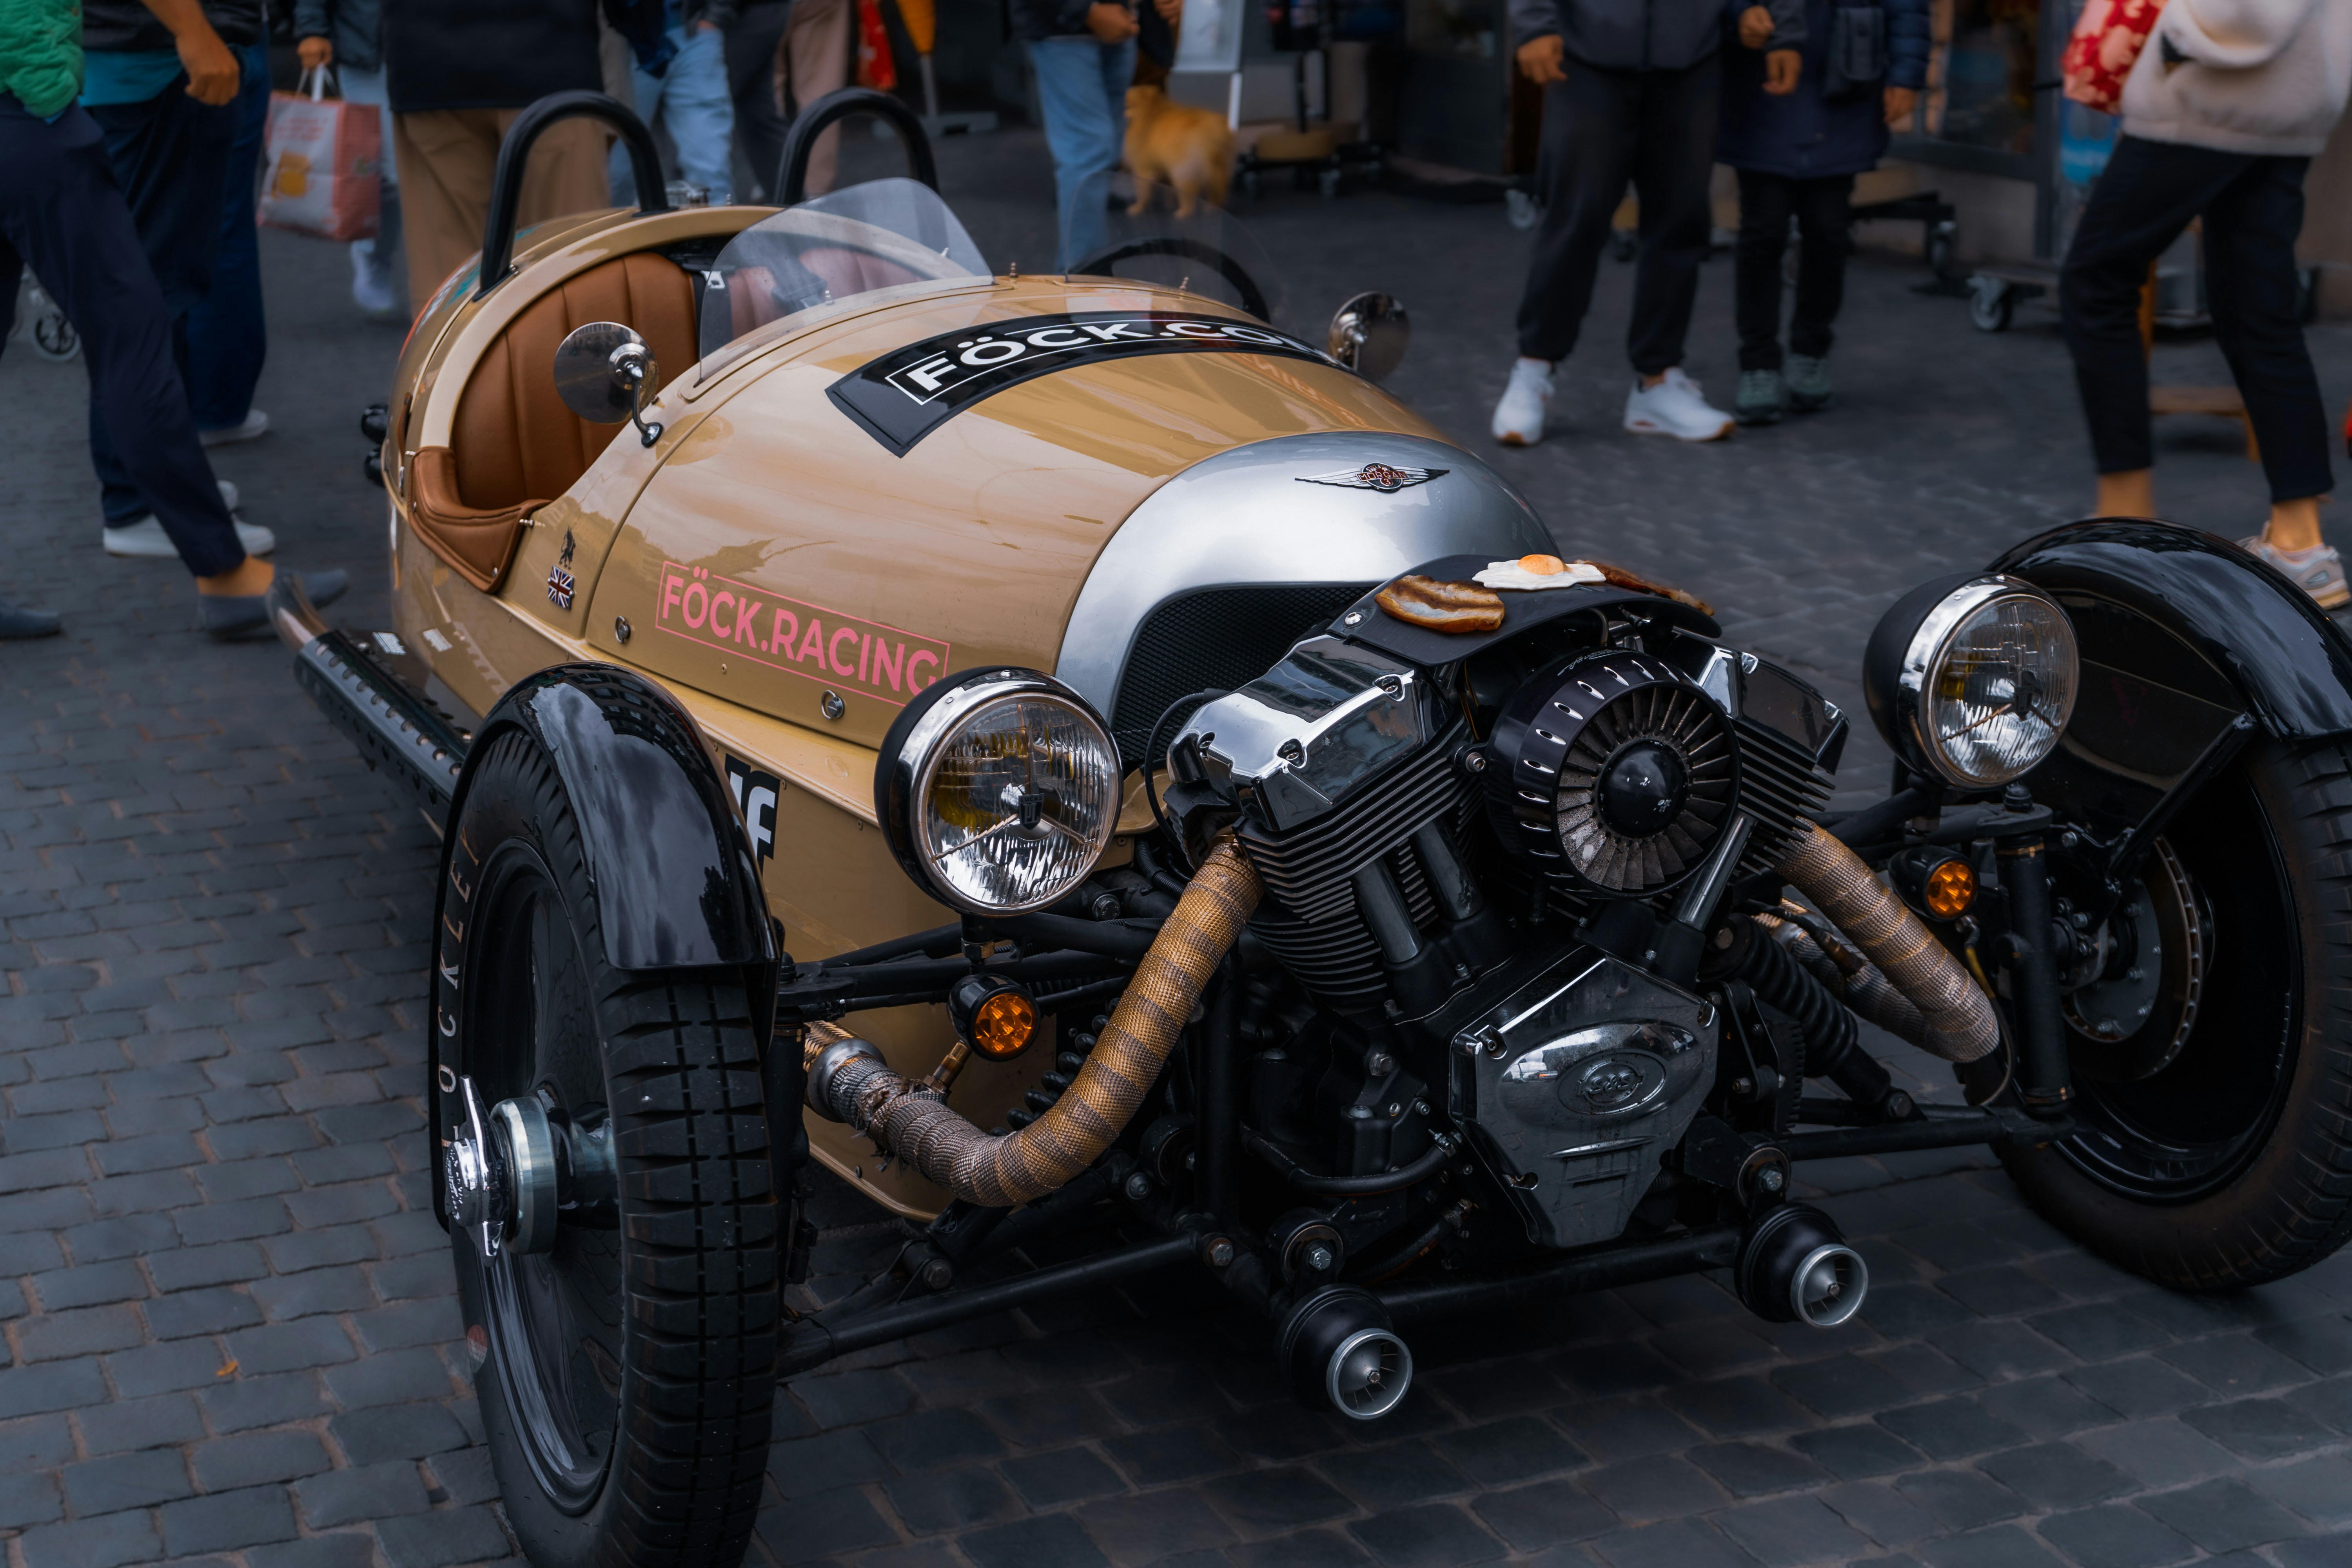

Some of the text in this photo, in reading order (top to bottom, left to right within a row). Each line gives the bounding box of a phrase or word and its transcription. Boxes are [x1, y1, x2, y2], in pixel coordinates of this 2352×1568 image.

[1357, 472, 1407, 481] MORGAN
[662, 566, 939, 697] FÖCK.RACING
[1590, 1073, 1634, 1094] S&S
